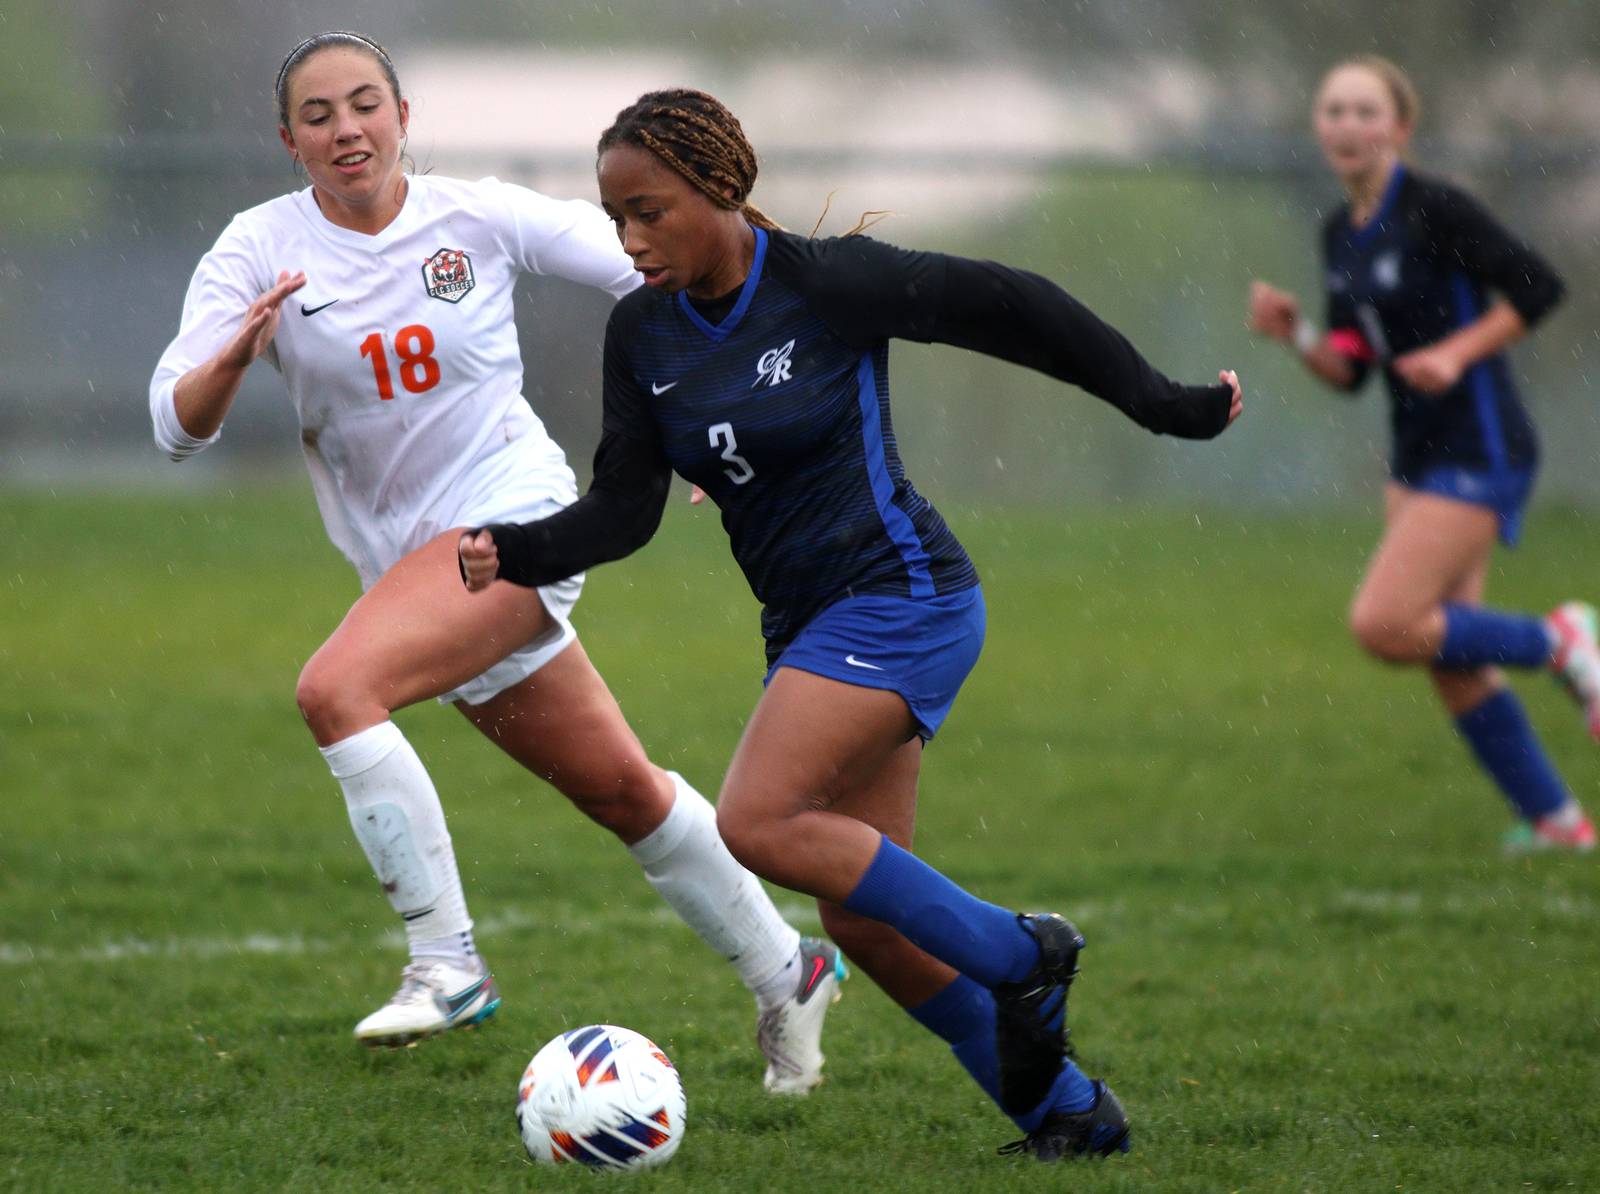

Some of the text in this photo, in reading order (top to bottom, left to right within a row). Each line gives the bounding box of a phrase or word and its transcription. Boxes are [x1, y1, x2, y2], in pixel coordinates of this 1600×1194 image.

[445, 280, 474, 293] SOCCER
[360, 324, 441, 400] 18
[708, 422, 755, 484] 3
